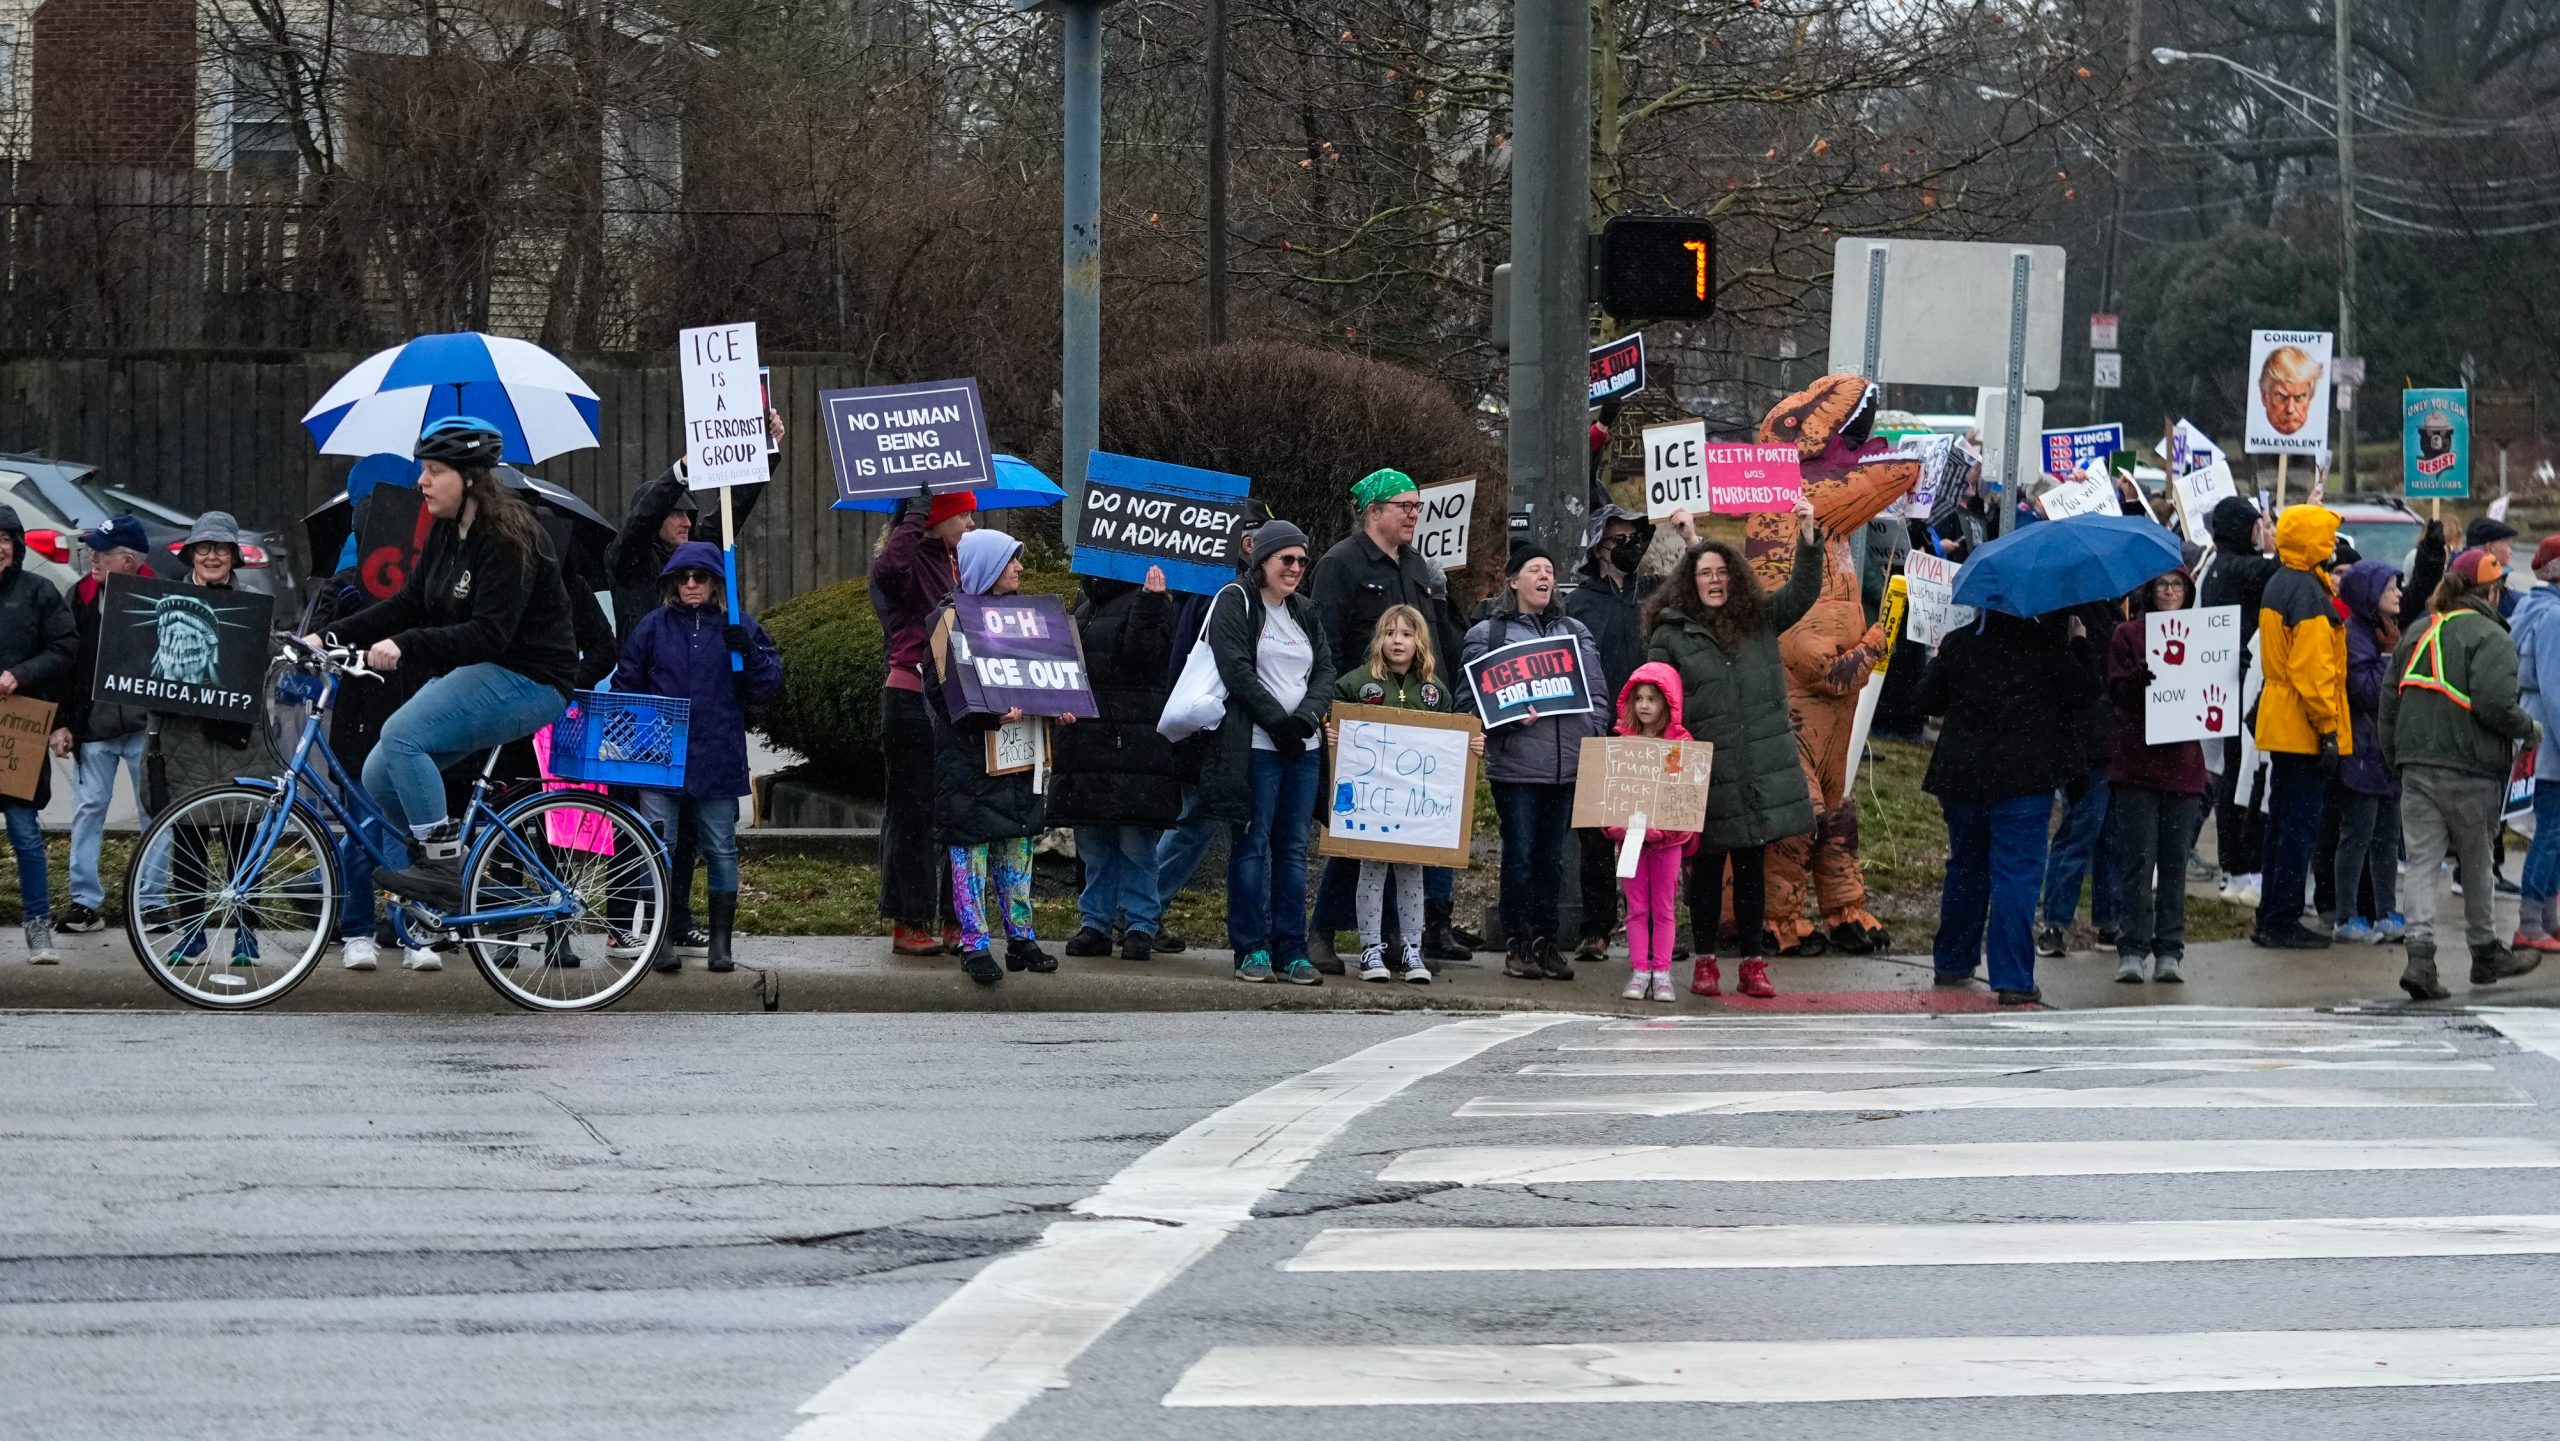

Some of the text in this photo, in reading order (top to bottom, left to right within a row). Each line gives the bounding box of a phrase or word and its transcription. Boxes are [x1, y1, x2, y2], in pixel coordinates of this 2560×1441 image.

[1683, 241, 1706, 300] 7
[694, 330, 742, 366] ICE
[2264, 332, 2323, 344] CORRUPT
[711, 371, 726, 388] IS
[1610, 368, 1636, 390] GOOD
[717, 394, 727, 412] A
[2407, 398, 2465, 417] ONLY YOU CAN
[690, 416, 763, 443] TERRORIST
[847, 405, 961, 432] NO HUMAN
[876, 430, 940, 452] BEING
[2050, 430, 2113, 446] NO KINGS
[2250, 437, 2323, 448] MALEVOLENT
[702, 443, 757, 467] GROUP
[1655, 440, 1698, 471] ICE
[1708, 447, 1800, 464] KEITH PORTER
[2050, 445, 2095, 458] NO ICE
[855, 450, 971, 477] IS ILLEGAL
[1744, 469, 1766, 479] was
[2051, 461, 2073, 471] NO
[2418, 454, 2455, 473] RESIST
[1651, 475, 1702, 505] OUT!
[2191, 470, 2215, 497] ICE
[1712, 485, 1803, 505] MURDERED TOO!
[1087, 489, 1241, 535] DO NOT OBEY
[1426, 493, 1465, 522] NO
[1091, 517, 1228, 557] IN ADVANCE
[2207, 614, 2231, 628] ICE
[2200, 649, 2230, 664] OUT
[975, 657, 1080, 690] ICE OUT
[1486, 652, 1566, 689] ICE OUT
[1495, 676, 1573, 705] FOR GOOD
[2152, 688, 2186, 704] NOW
[1001, 726, 1022, 745] DUE
[999, 741, 1035, 764] PROCES
[1607, 744, 1656, 760] Fuck
[1358, 781, 1395, 817] ICE
[1607, 779, 1651, 798] Fuck
